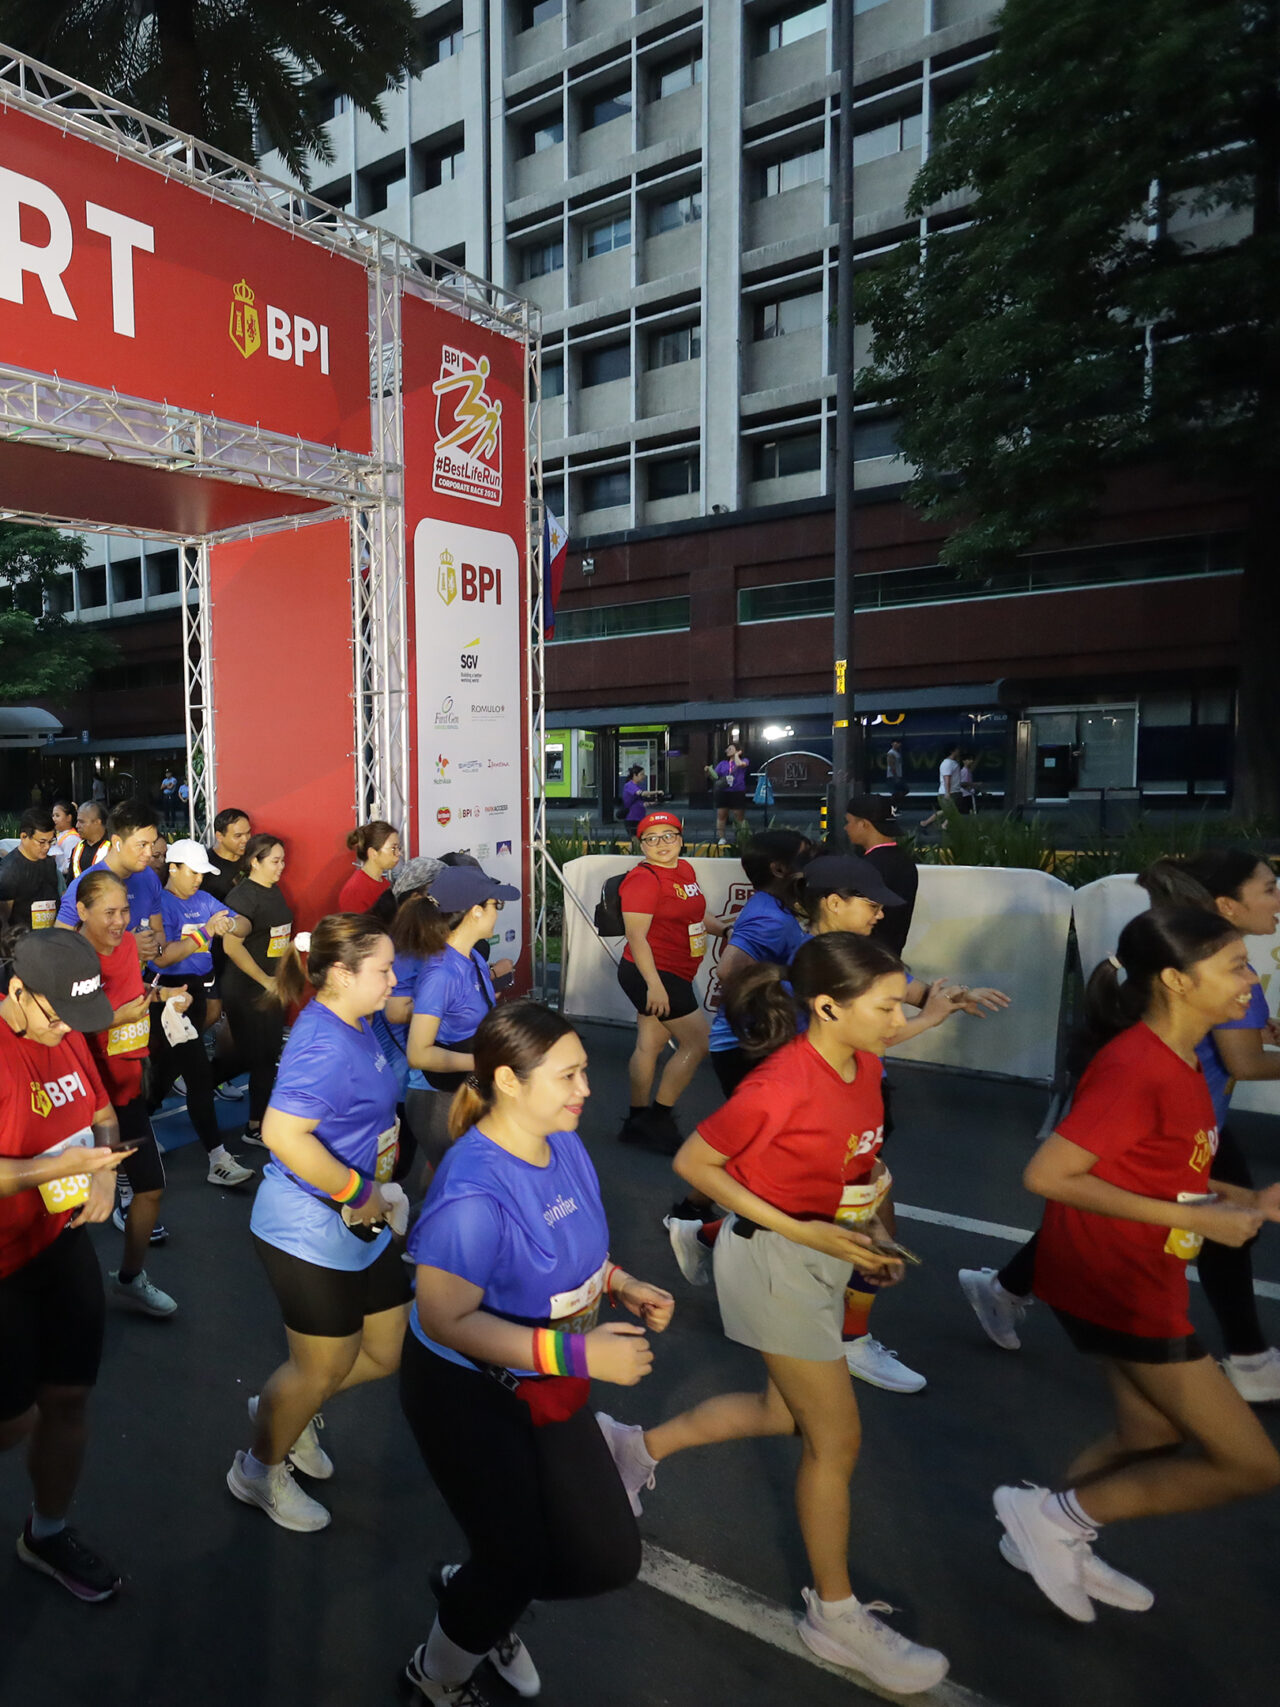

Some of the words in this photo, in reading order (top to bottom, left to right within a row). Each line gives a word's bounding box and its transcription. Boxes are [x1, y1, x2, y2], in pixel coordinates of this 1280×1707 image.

[266, 304, 329, 375] BPI
[444, 350, 460, 367] BPI
[436, 456, 500, 487] #BestLifeRun
[438, 477, 470, 491] CORPORATE
[470, 484, 484, 496] RACE
[461, 562, 502, 606] BPI
[461, 654, 479, 669] SGV
[471, 704, 501, 713] ROMULO
[462, 808, 472, 818] BPI
[111, 1020, 150, 1043] 35888
[44, 1071, 87, 1108] BPI
[854, 1125, 884, 1156] BP
